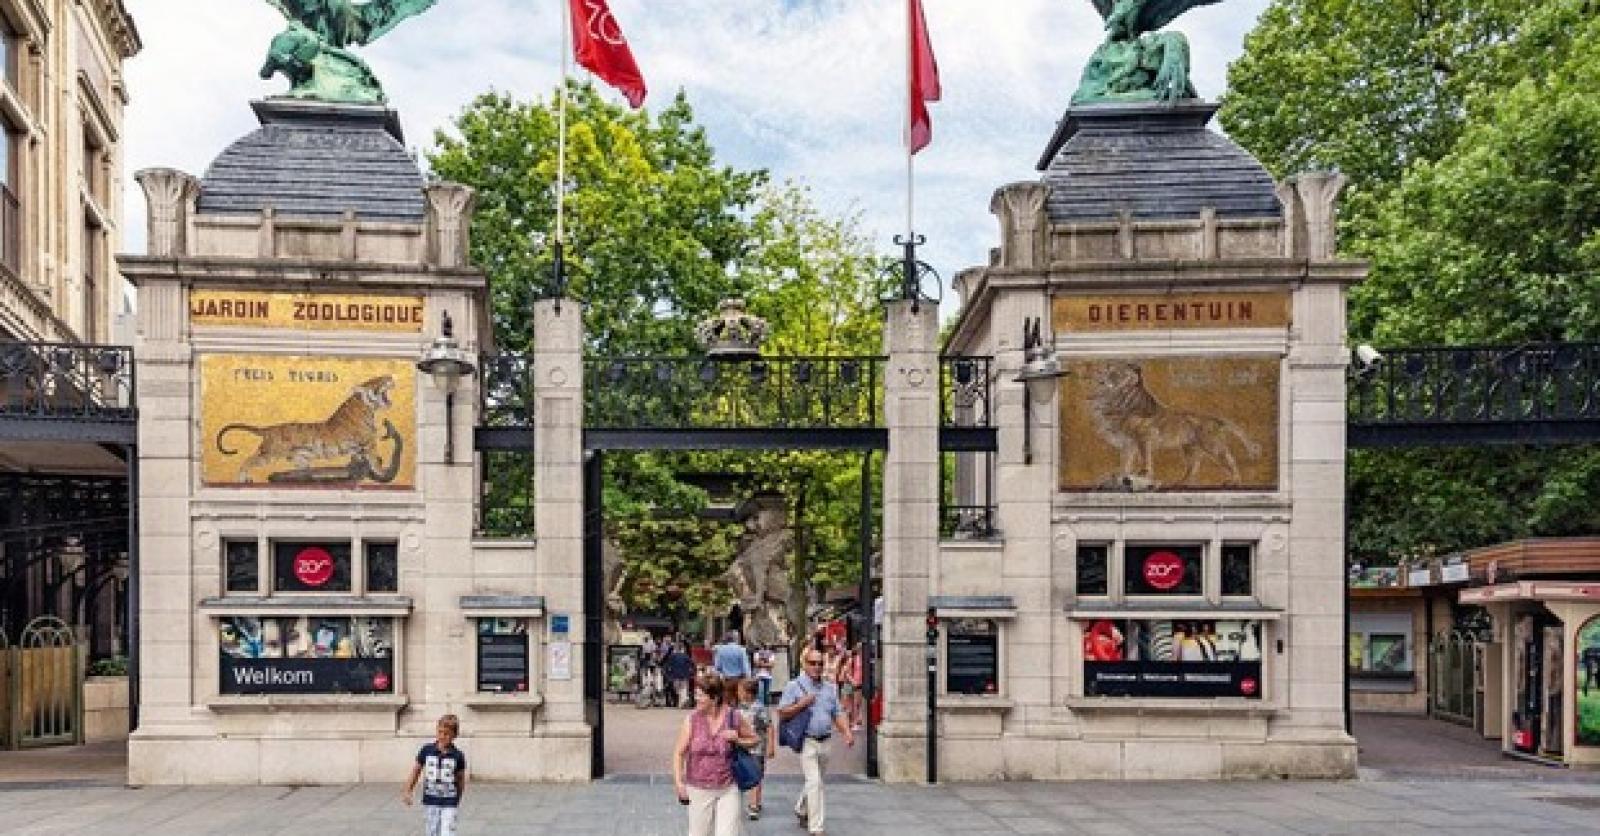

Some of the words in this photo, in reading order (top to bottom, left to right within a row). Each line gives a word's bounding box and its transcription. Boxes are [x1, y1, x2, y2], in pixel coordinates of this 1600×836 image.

[191, 299, 269, 318] JARDIN
[293, 301, 424, 323] ZOOLOGIQUE
[1088, 302, 1253, 322] DIERENTUIN
[232, 667, 314, 685] Welkom
